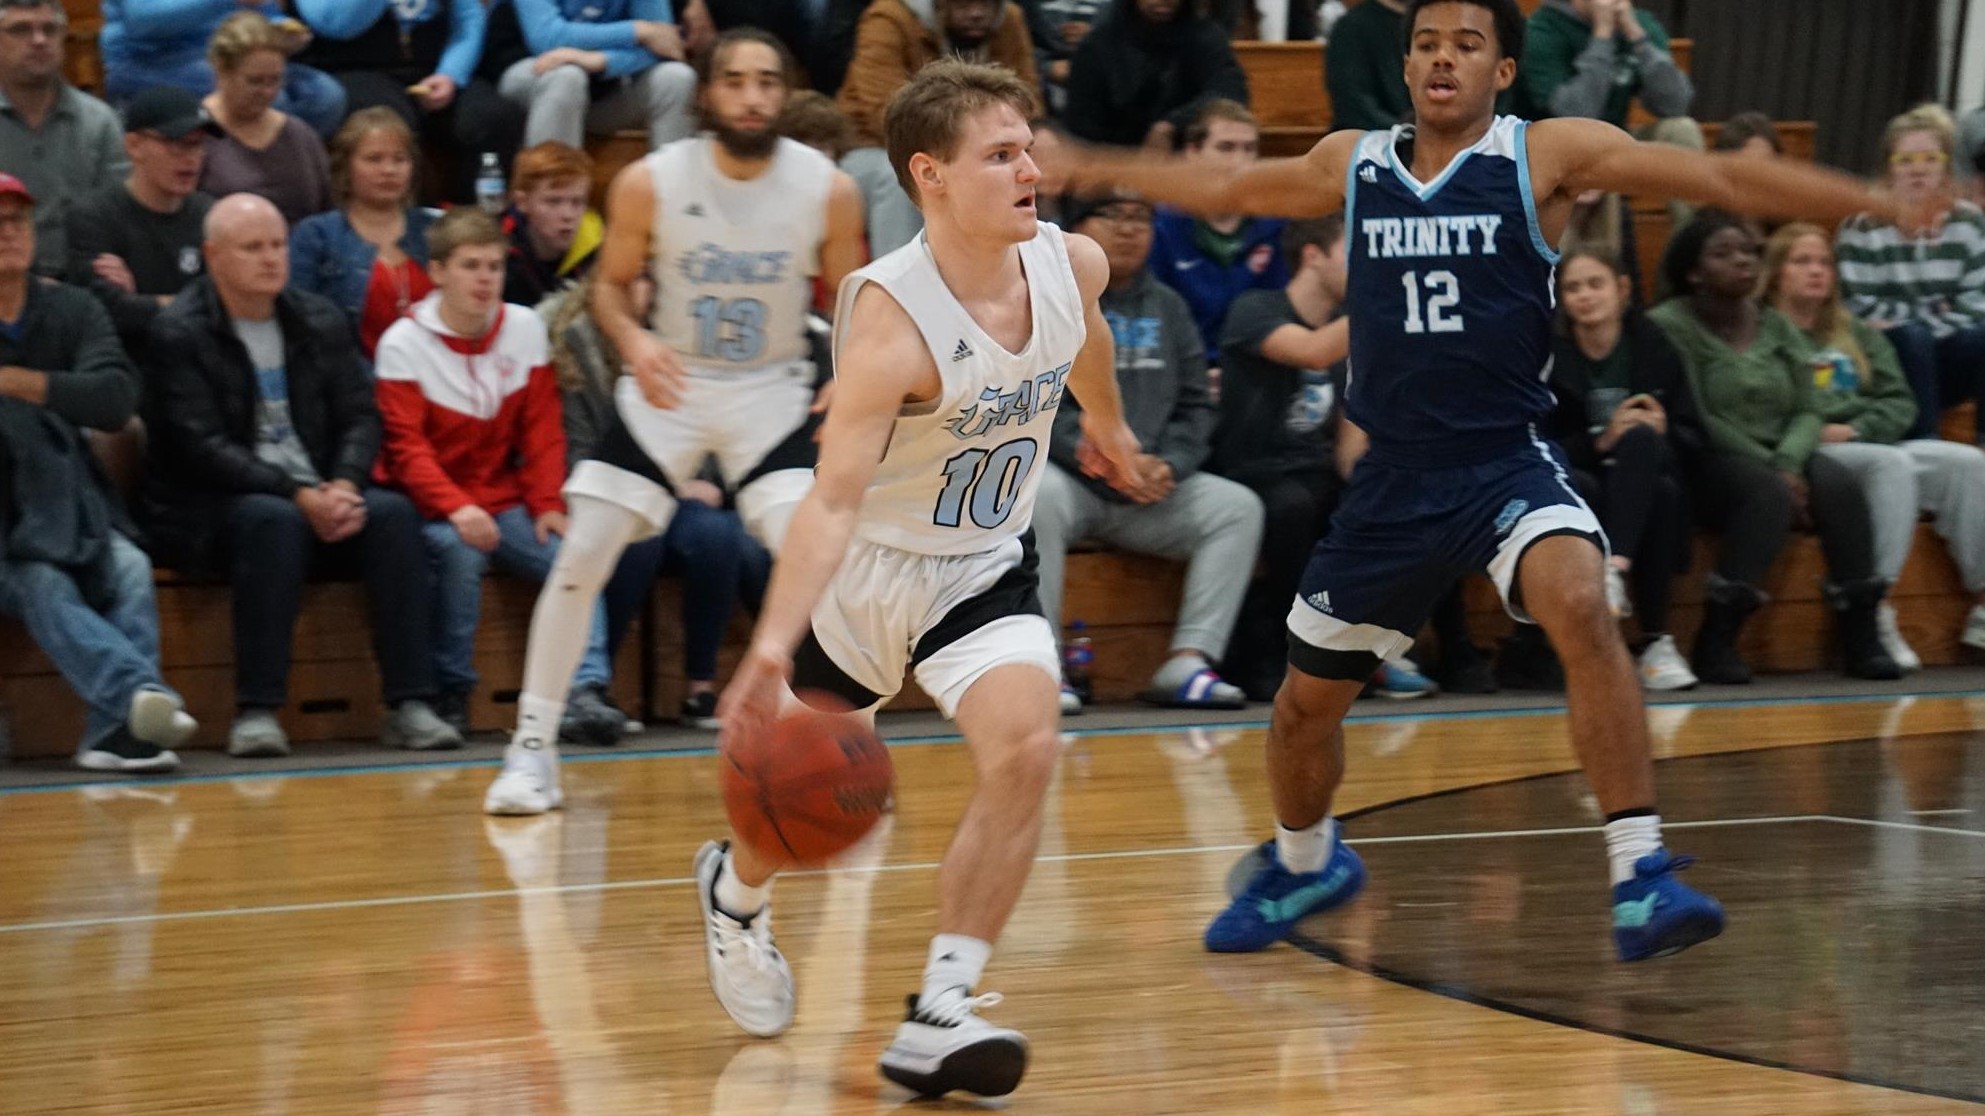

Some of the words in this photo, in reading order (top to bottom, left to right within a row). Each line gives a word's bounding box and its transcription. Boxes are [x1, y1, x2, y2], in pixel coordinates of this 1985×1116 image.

[1362, 214, 1502, 258] TRINITY
[690, 295, 767, 361] 13
[1401, 270, 1464, 333] 12
[940, 361, 1072, 441] GRACE
[933, 437, 1038, 529] 10
